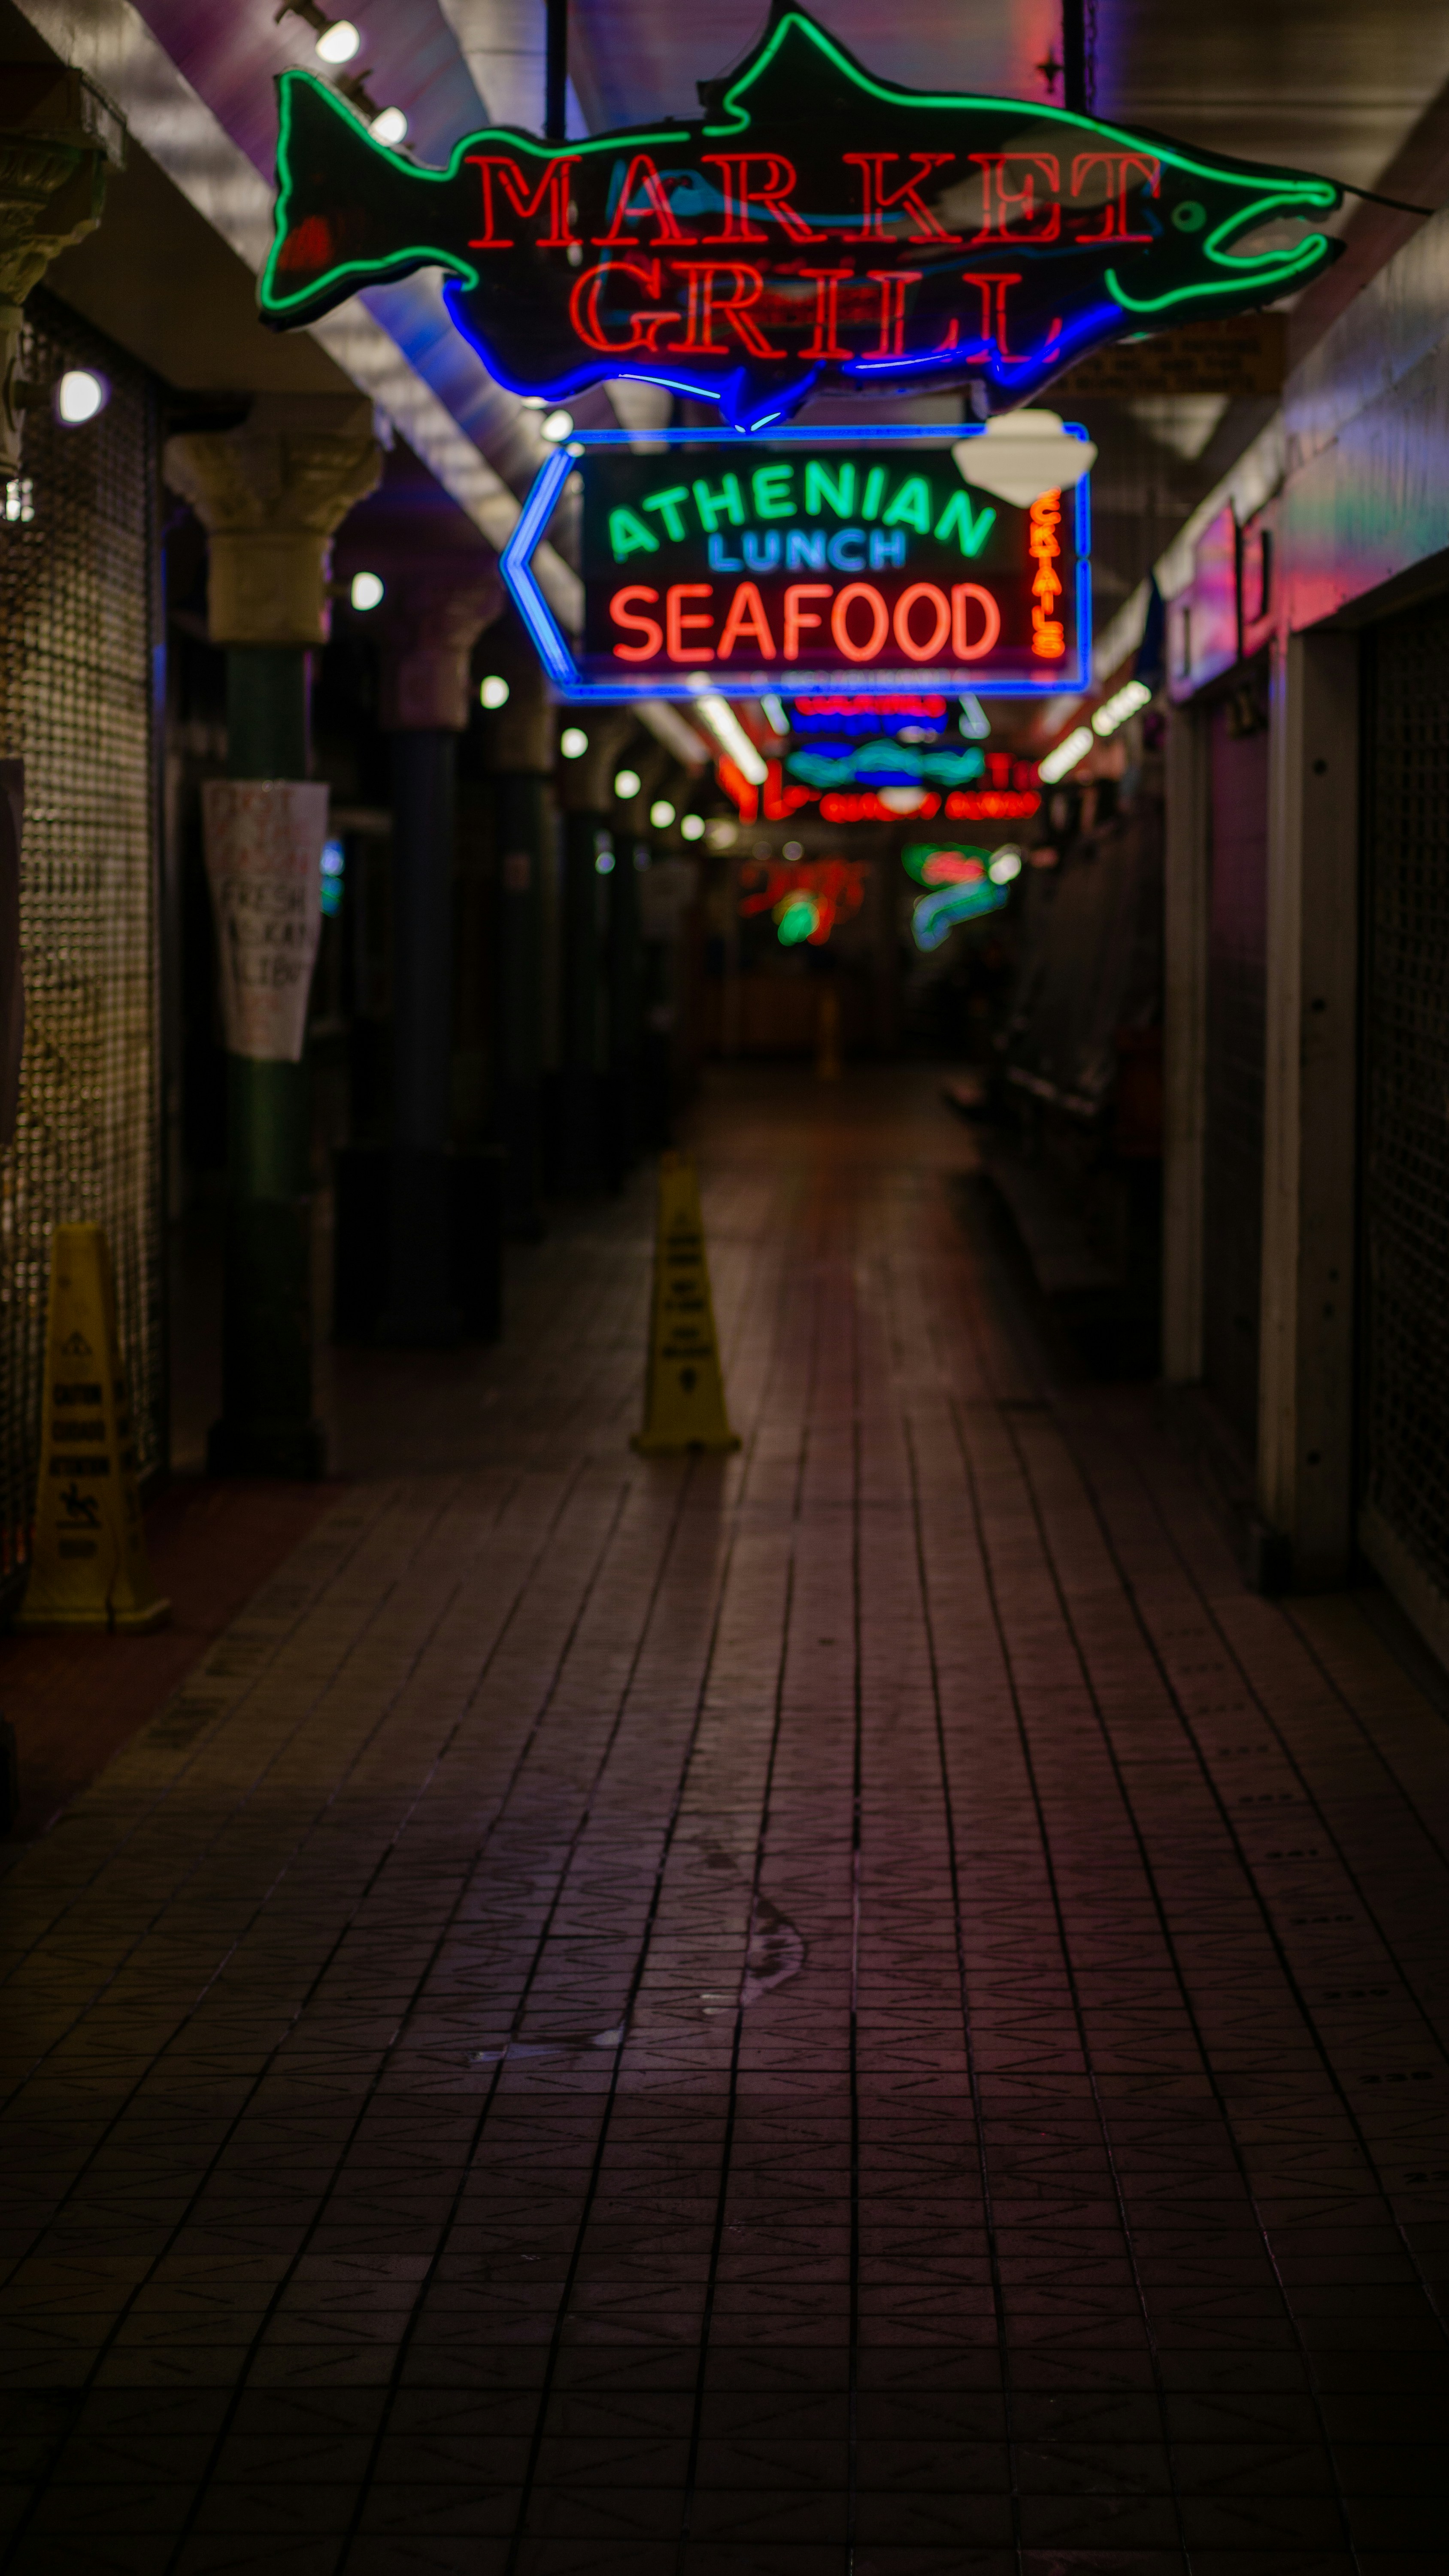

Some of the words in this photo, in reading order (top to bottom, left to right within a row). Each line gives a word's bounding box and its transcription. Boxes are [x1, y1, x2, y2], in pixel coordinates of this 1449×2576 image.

[466, 152, 1161, 247] MARKET
[569, 261, 1062, 364] GRILL
[608, 460, 997, 562] ATHENIAN
[707, 530, 906, 572] LUNCH
[609, 581, 1001, 662] SEAFOOD
